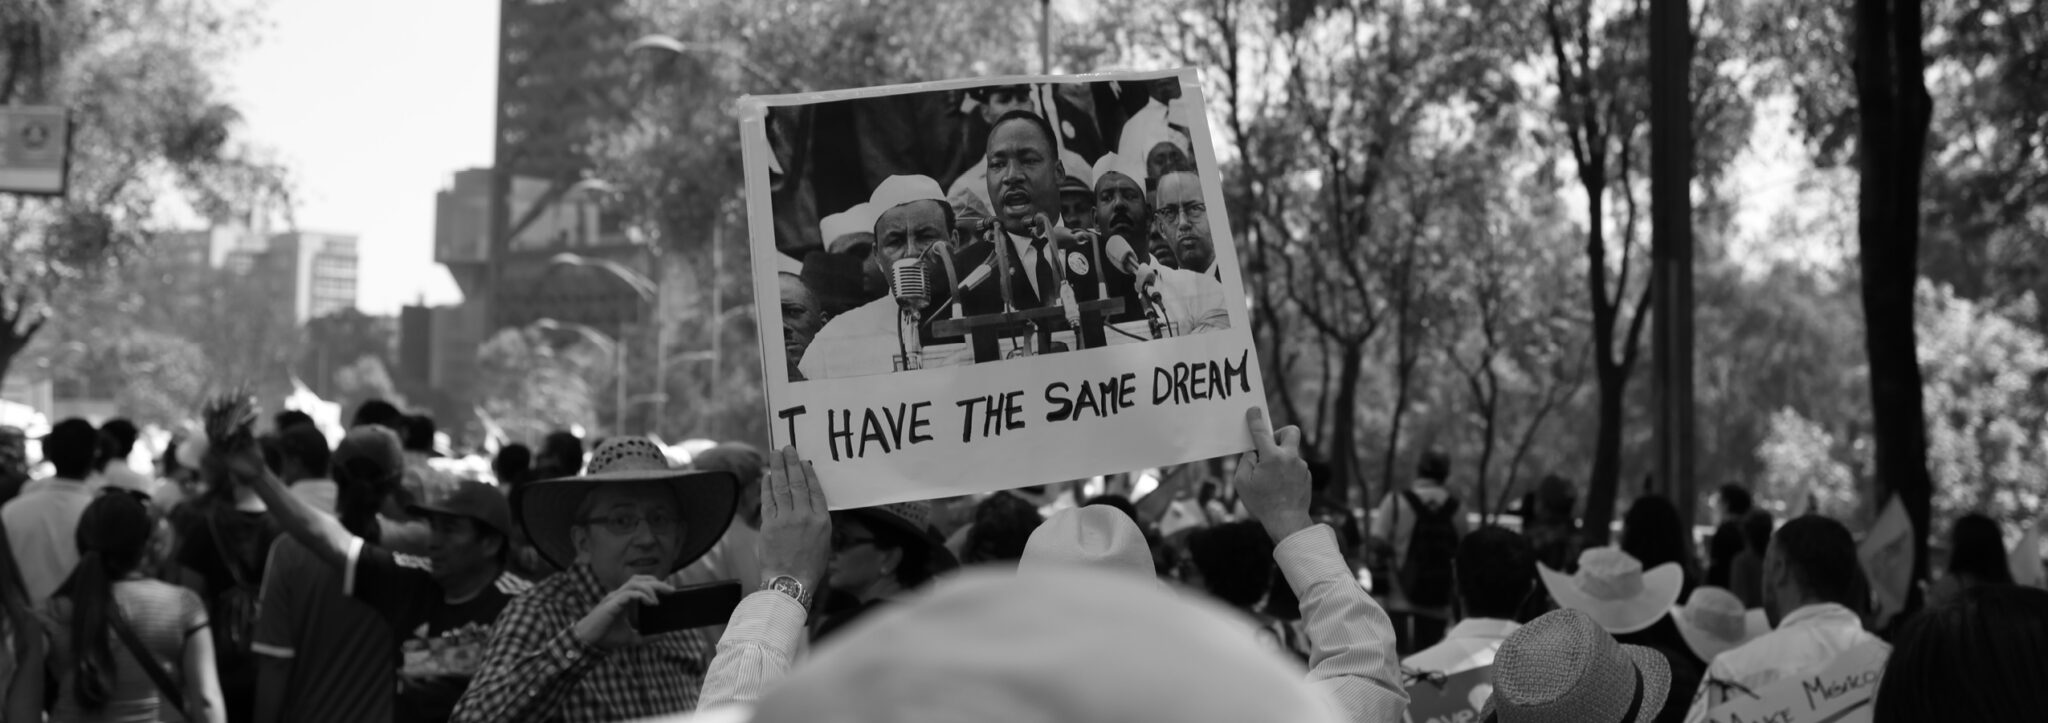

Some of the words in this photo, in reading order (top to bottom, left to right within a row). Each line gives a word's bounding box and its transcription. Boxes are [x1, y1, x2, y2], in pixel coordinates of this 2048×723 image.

[778, 405, 812, 465] I
[827, 400, 934, 462] HAVE
[956, 390, 1026, 443] THE
[1044, 372, 1136, 422] SAME
[1152, 349, 1251, 406] DREAM
